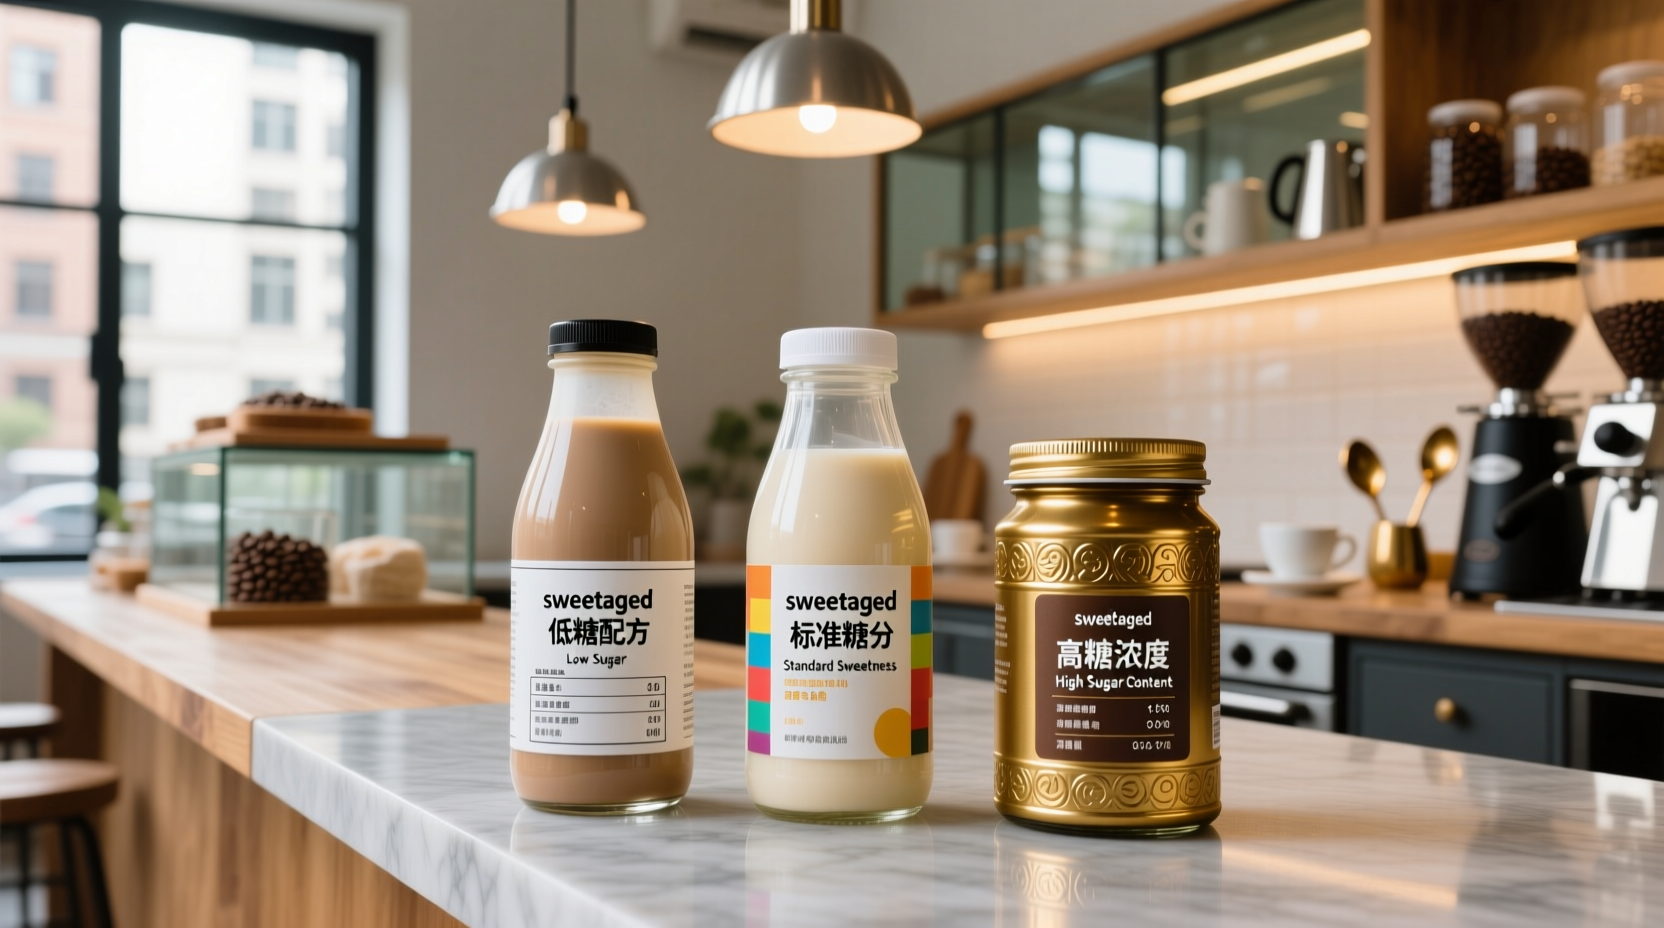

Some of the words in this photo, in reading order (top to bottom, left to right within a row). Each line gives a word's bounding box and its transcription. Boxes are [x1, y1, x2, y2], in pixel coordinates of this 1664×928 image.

[543, 588, 653, 615] sweetaged
[785, 589, 897, 617] sweetaged
[548, 617, 650, 646] 低糖配方
[1074, 611, 1152, 629] sweetaged
[789, 620, 894, 650] 标准糖分
[566, 653, 589, 665] Low
[592, 653, 627, 669] Sugar
[783, 659, 834, 672] Standard
[837, 660, 897, 672] Sweetness
[1056, 638, 1170, 670] 高糖浓度
[1055, 674, 1084, 691] High
[1087, 674, 1125, 692] Sugar
[1126, 676, 1173, 689] Content
